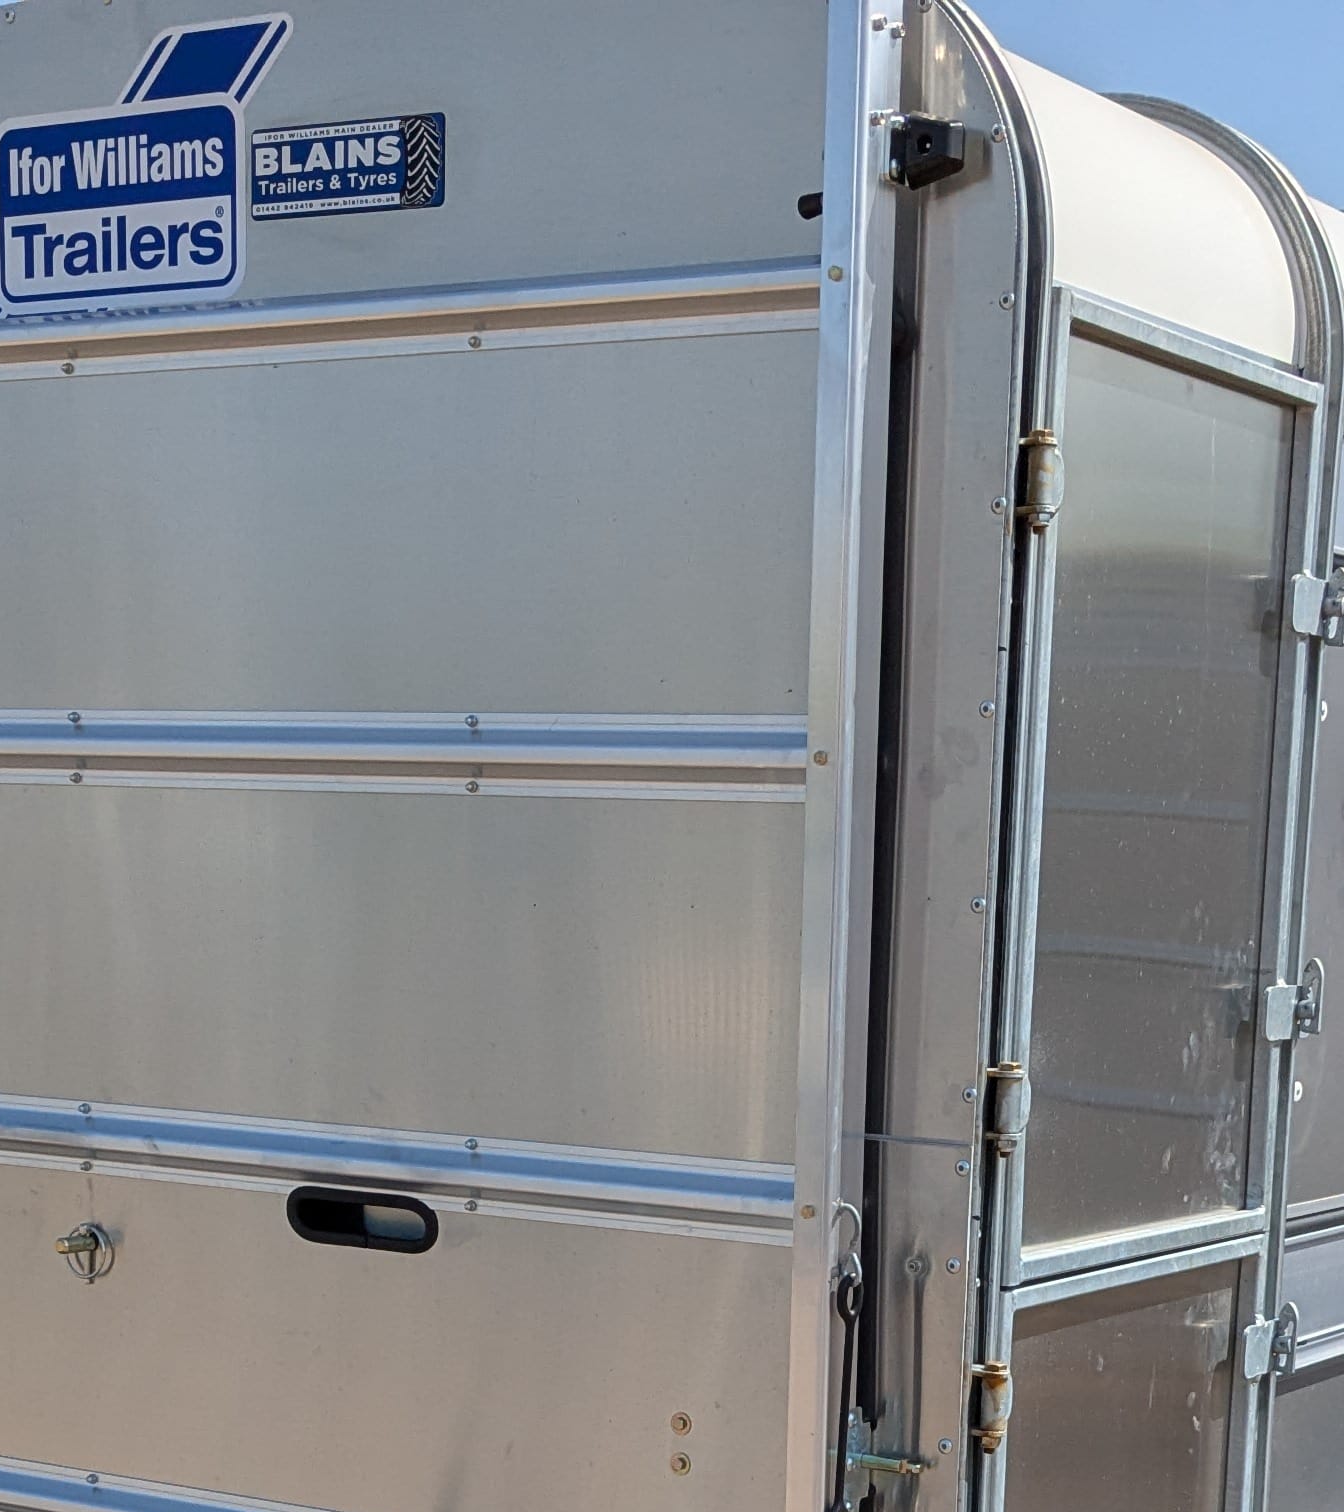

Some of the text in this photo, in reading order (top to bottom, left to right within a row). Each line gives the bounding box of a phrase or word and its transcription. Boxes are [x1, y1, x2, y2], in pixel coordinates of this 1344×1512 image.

[264, 122, 395, 142] IFOR WILLIAMS MAIN DEALER
[9, 134, 225, 197] Ifor Williams
[255, 135, 402, 177] BLAINS
[258, 172, 397, 196] Trailers & Tyres
[11, 215, 224, 280] Trailers
